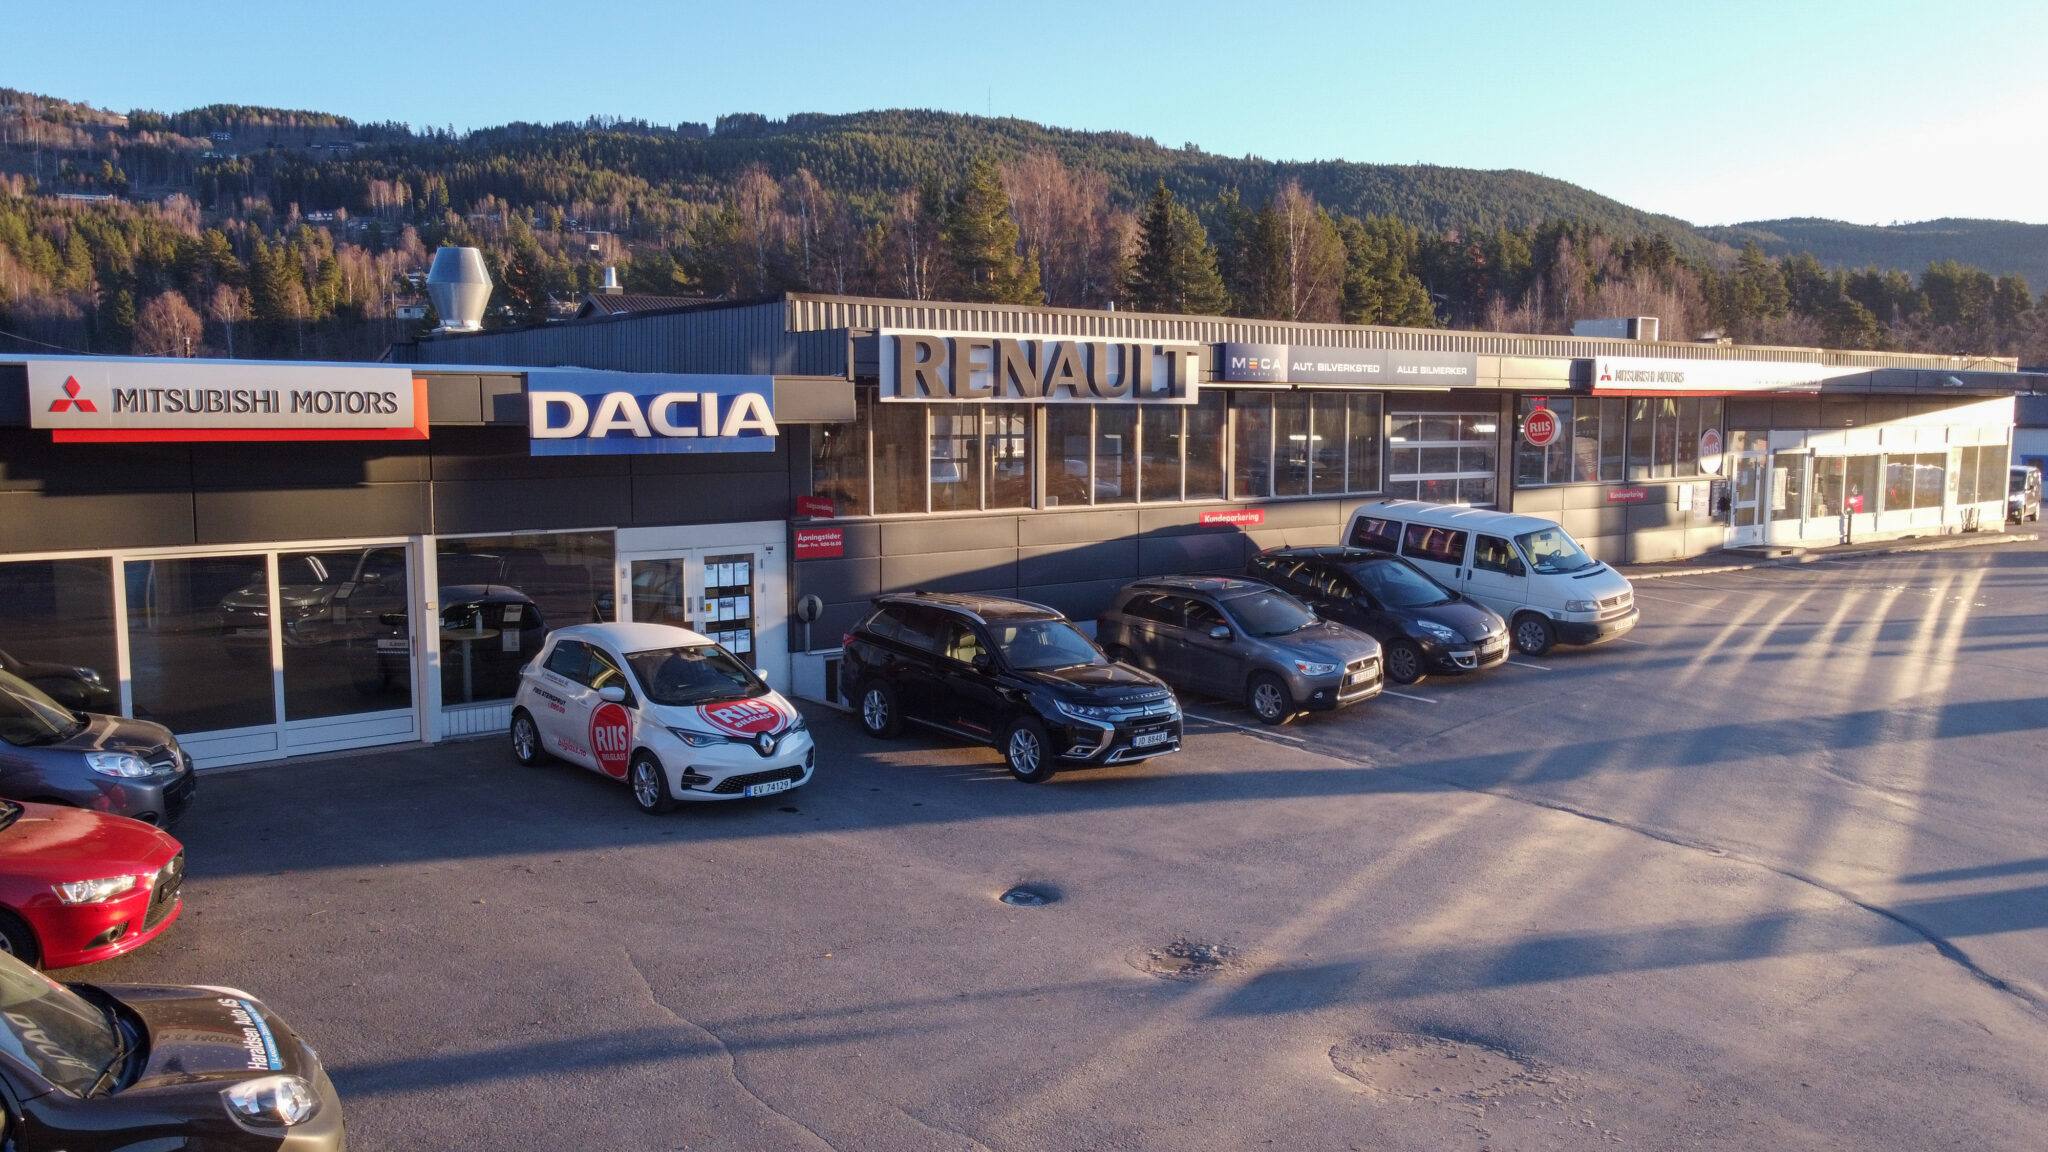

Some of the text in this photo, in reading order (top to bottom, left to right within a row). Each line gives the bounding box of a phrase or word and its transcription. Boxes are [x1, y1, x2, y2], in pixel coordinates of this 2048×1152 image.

[893, 334, 1199, 399] RENAULT
[1232, 357, 1280, 369] MECA
[1293, 362, 1380, 373] AUT. BILVERKSTED
[1397, 366, 1467, 375] ALLE BILMERKER
[1615, 369, 1685, 383] MITSUBISHI MOTORS
[112, 387, 399, 415] MITSUBISHI MOTORS
[528, 391, 779, 439] DACIA
[1530, 421, 1551, 432] RIIS
[1703, 442, 1719, 456] RIIS
[1204, 512, 1259, 523] Kundeparkering
[798, 533, 841, 543] Åpningstider
[712, 701, 770, 724] RIIS
[734, 711, 775, 728] BILGLASS
[595, 725, 627, 751] RIIS
[753, 781, 789, 795] EV 74129
[217, 998, 242, 1009] AS
[230, 1009, 255, 1027] Auto
[242, 1027, 269, 1071] Haraldsen
